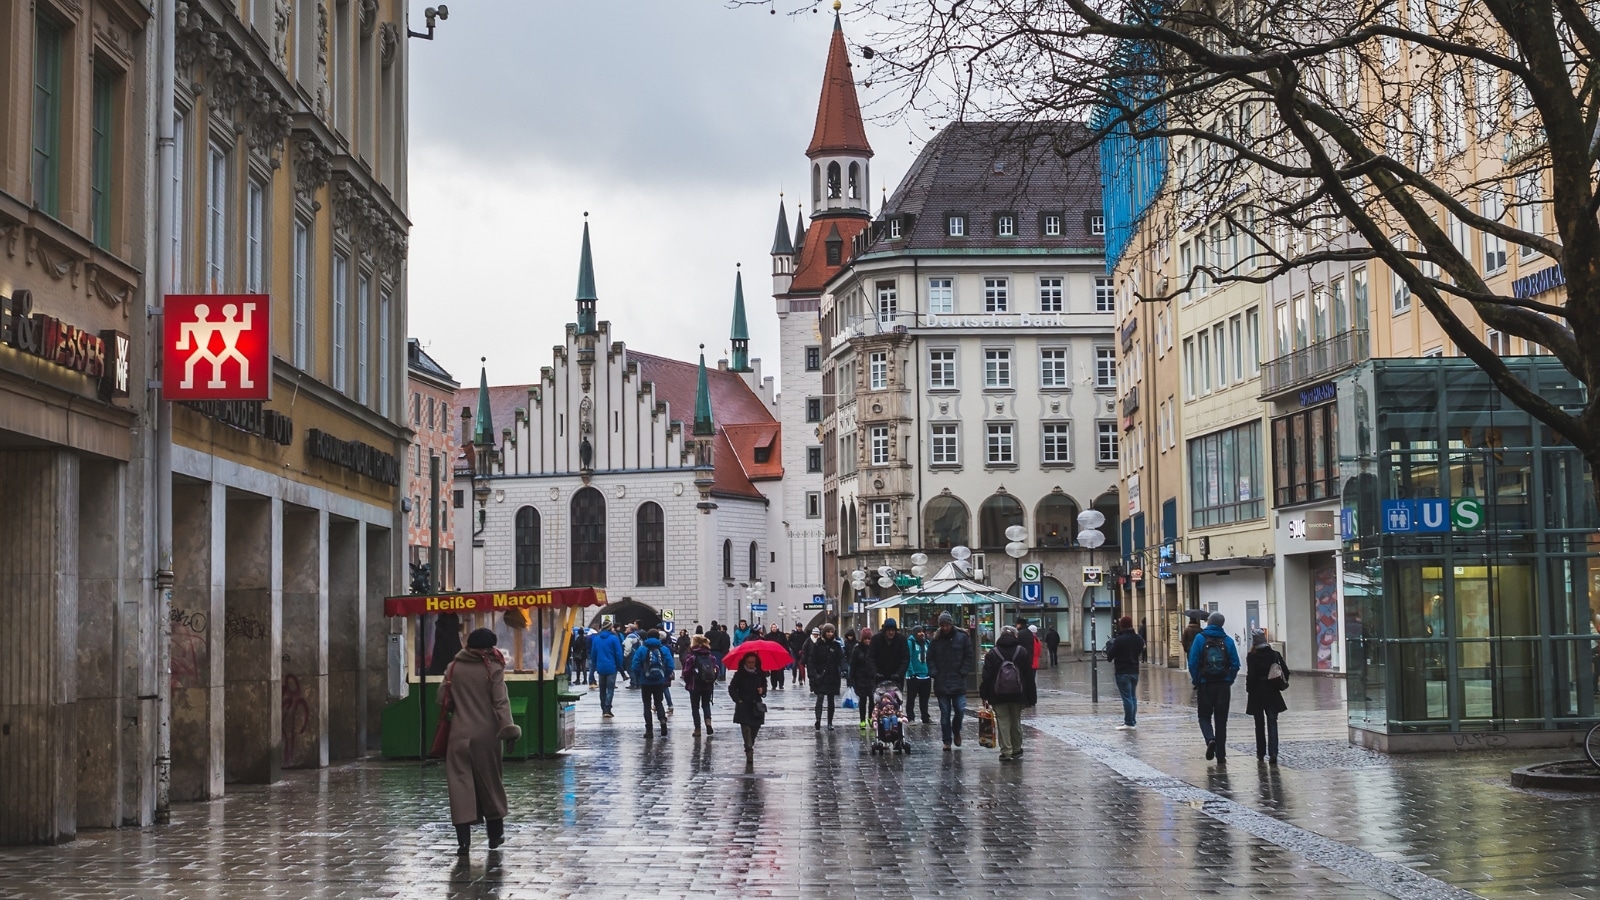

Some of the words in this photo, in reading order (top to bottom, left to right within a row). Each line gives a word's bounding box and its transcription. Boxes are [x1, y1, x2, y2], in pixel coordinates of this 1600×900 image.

[1512, 264, 1566, 299] WORMLA
[926, 313, 1013, 327] Deutsche
[1021, 313, 1066, 327] Bank
[39, 314, 105, 377] MESSER
[1423, 503, 1442, 528] U
[1456, 501, 1480, 529] S
[1024, 565, 1038, 580] S
[426, 596, 477, 611] Heiße
[493, 591, 552, 607] Maroni
[1024, 585, 1038, 601] U
[664, 610, 673, 619] S
[663, 622, 672, 632] U
